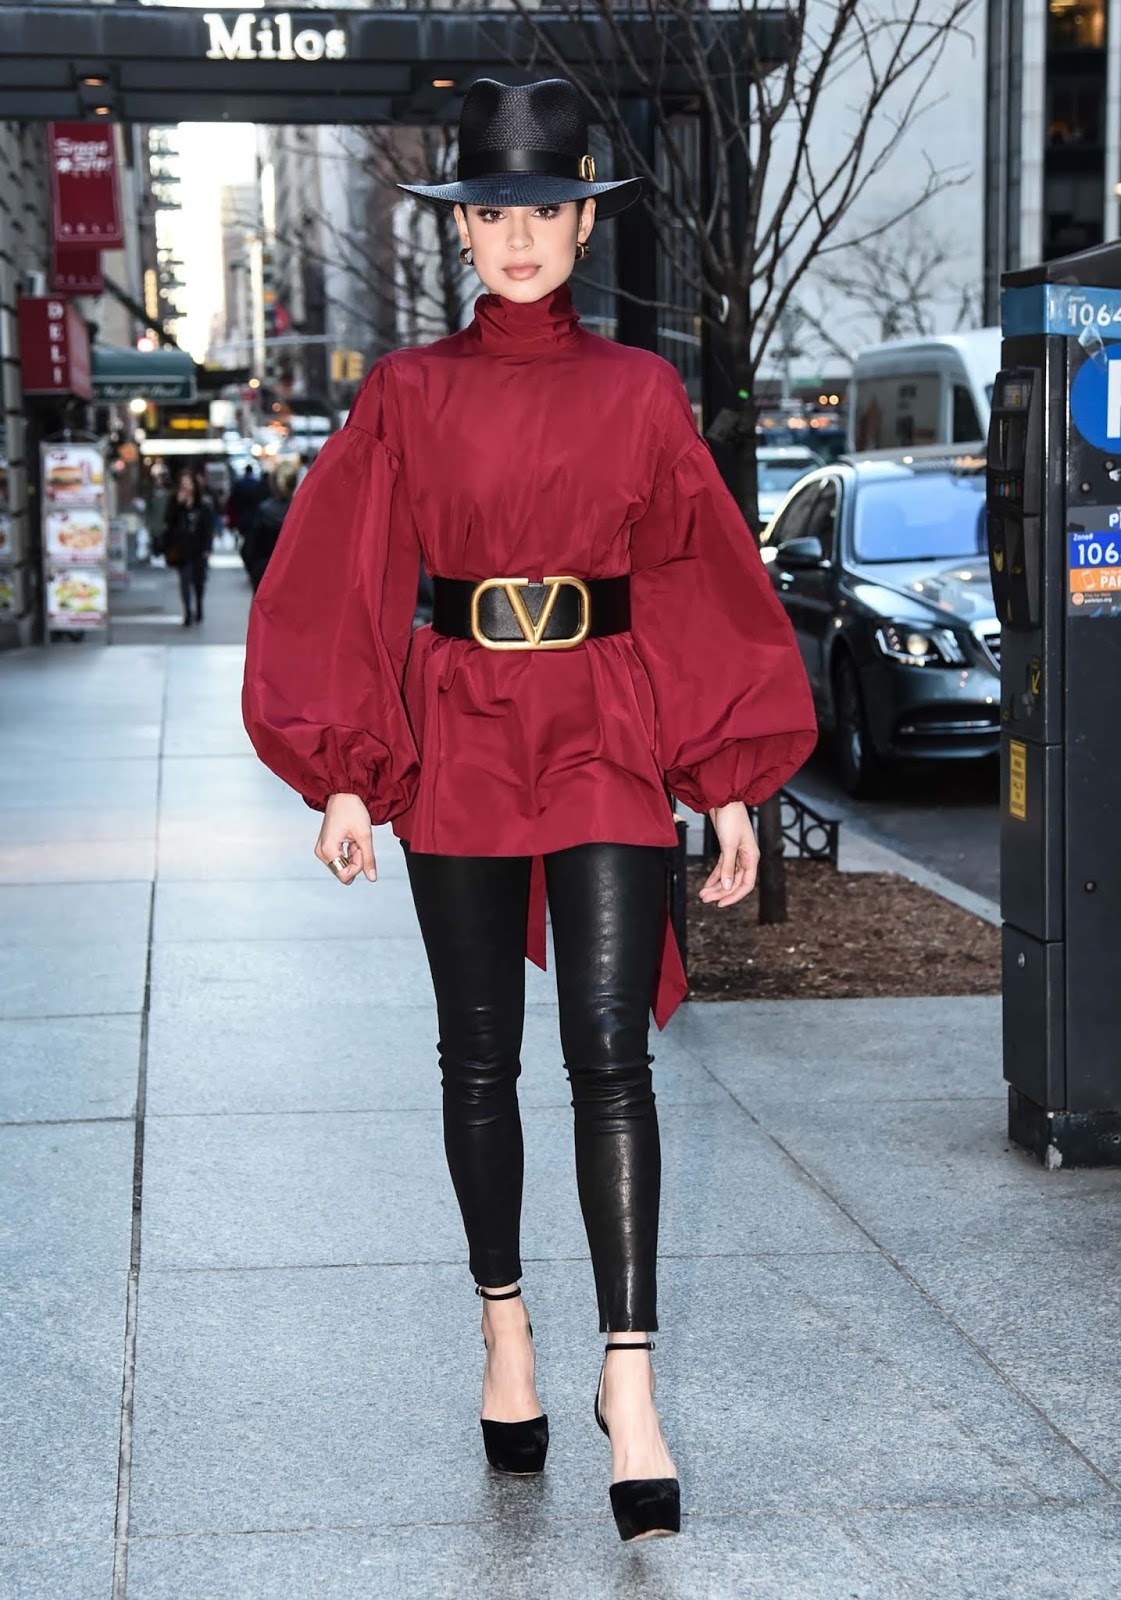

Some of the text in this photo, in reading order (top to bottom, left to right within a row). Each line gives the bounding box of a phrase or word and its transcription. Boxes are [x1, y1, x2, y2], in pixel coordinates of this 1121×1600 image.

[203, 12, 347, 61] Milos
[47, 300, 66, 385] DELI
[1078, 542, 1121, 566] 106
